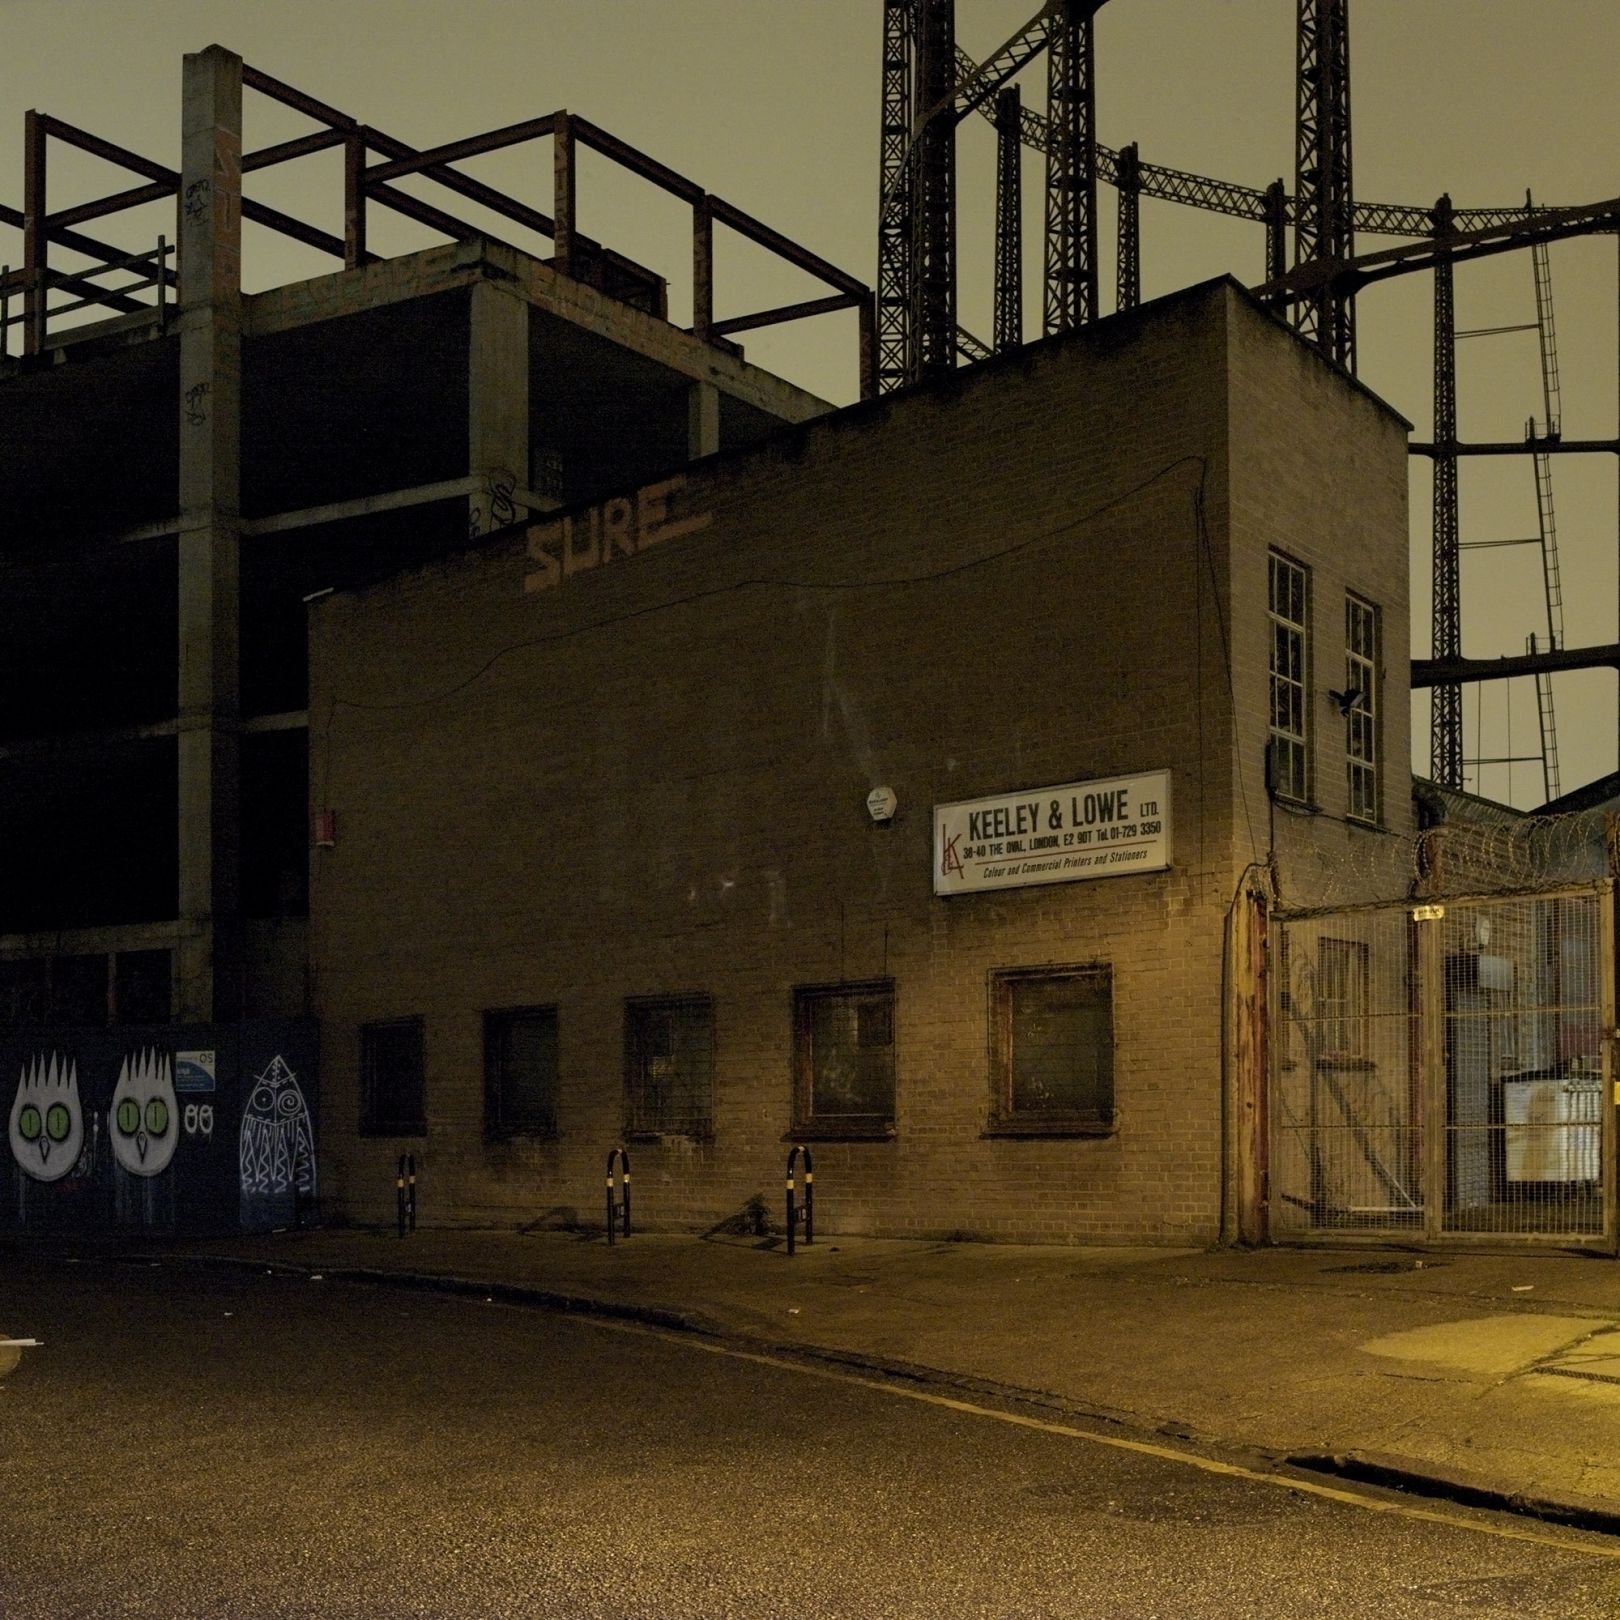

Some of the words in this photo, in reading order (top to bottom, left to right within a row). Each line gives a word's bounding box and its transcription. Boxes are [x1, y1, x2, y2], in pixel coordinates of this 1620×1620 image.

[524, 472, 713, 593] SURE
[969, 803, 1039, 841] KEELEY
[1049, 800, 1063, 830] &
[1072, 789, 1129, 827] LOWE
[1140, 801, 1159, 817] LTD.
[989, 843, 1003, 856] THE
[1064, 833, 1074, 846] E2
[1110, 824, 1137, 839] 01-729
[1140, 820, 1161, 836] 3350
[983, 866, 1005, 879] Colour
[1007, 864, 1020, 875] and
[1022, 858, 1062, 874] Commercial
[1063, 855, 1092, 869] Printers
[1094, 853, 1107, 865] and
[1109, 849, 1148, 863] Stationers
